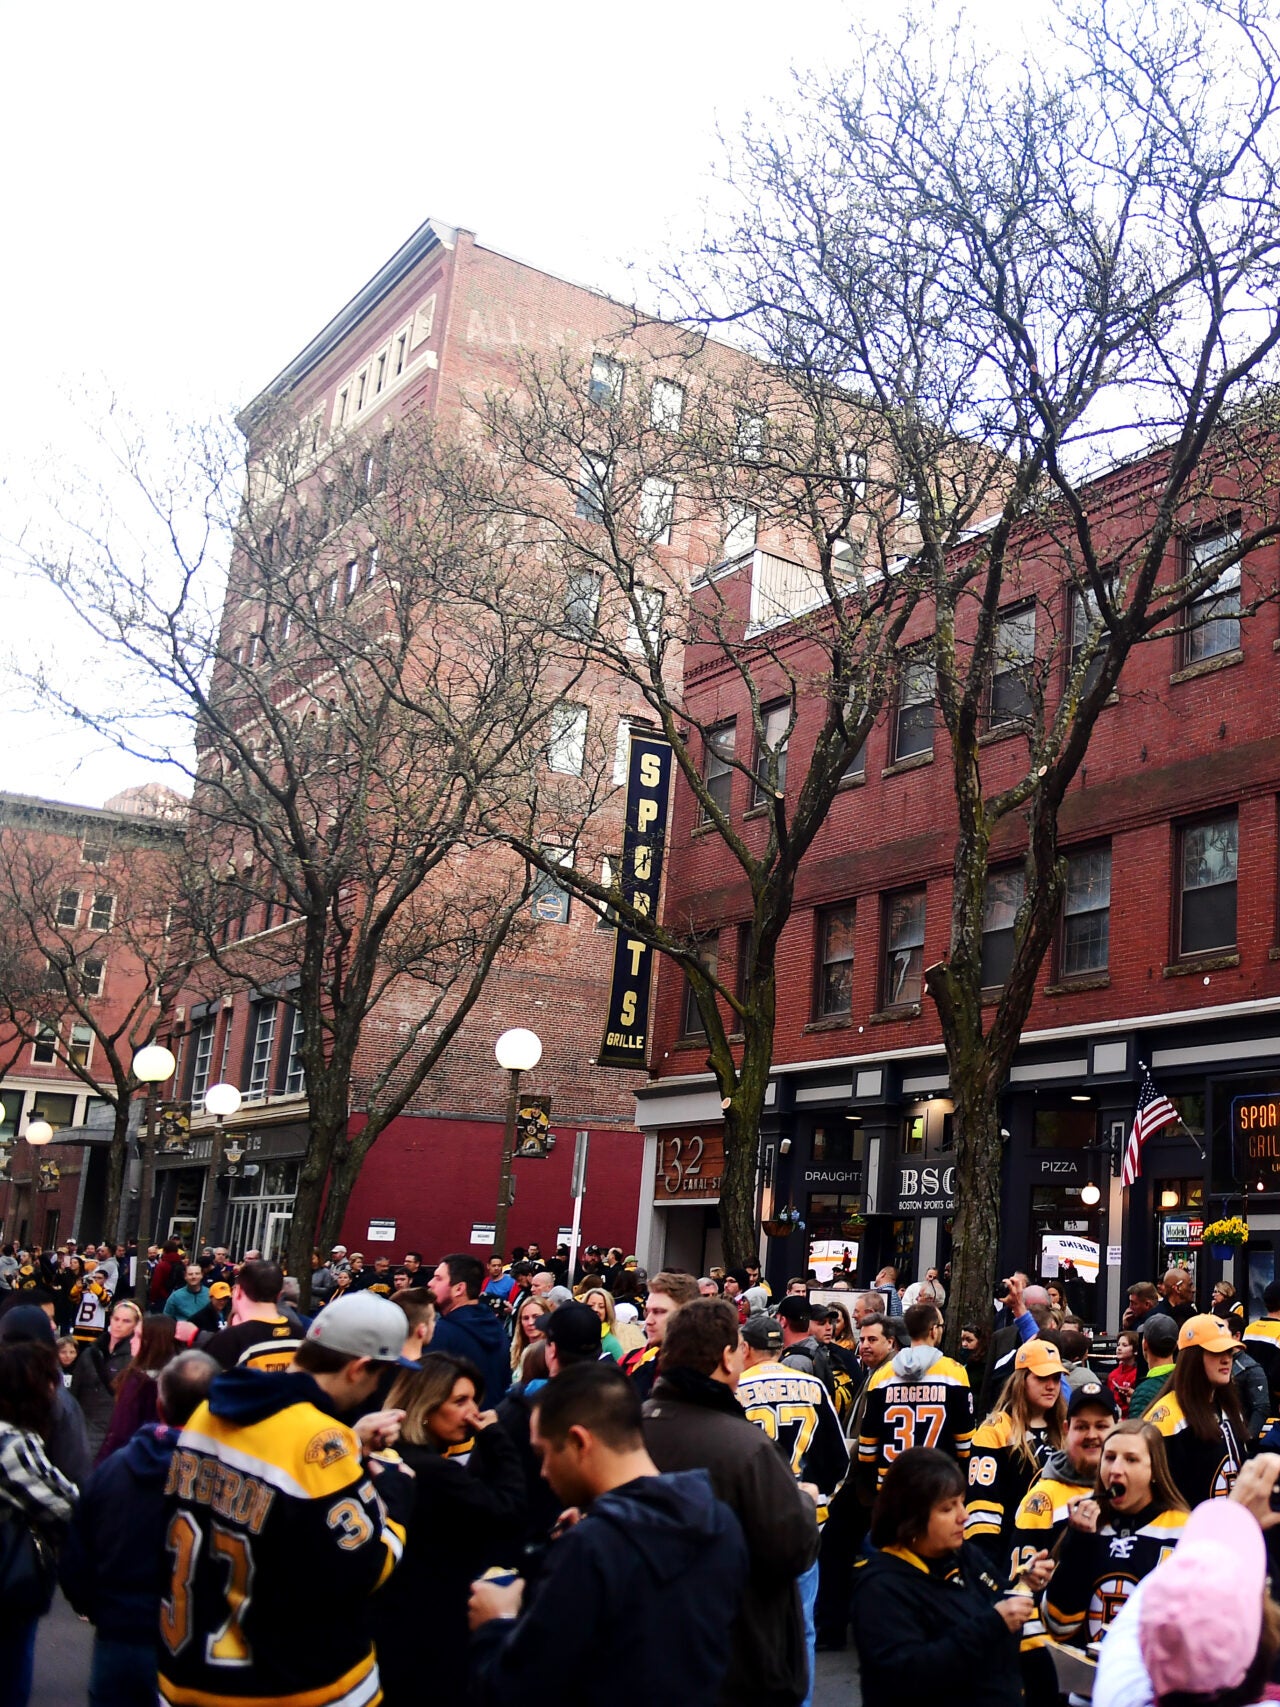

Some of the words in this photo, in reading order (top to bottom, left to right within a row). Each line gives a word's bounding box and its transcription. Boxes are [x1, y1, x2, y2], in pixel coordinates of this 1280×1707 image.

[620, 753, 660, 1027] SPORTS
[606, 1032, 644, 1049] GRILLE
[657, 1136, 704, 1193] 132
[1041, 1162, 1078, 1173] PIZZA
[899, 1200, 922, 1210] BOSTON
[923, 1200, 944, 1210] SPORTS
[1190, 1225, 1203, 1236] UF
[79, 1302, 97, 1322] B
[885, 1385, 946, 1403] BERGERON
[883, 1404, 947, 1463] 37
[968, 1456, 998, 1487] 88
[159, 1508, 256, 1667] 37
